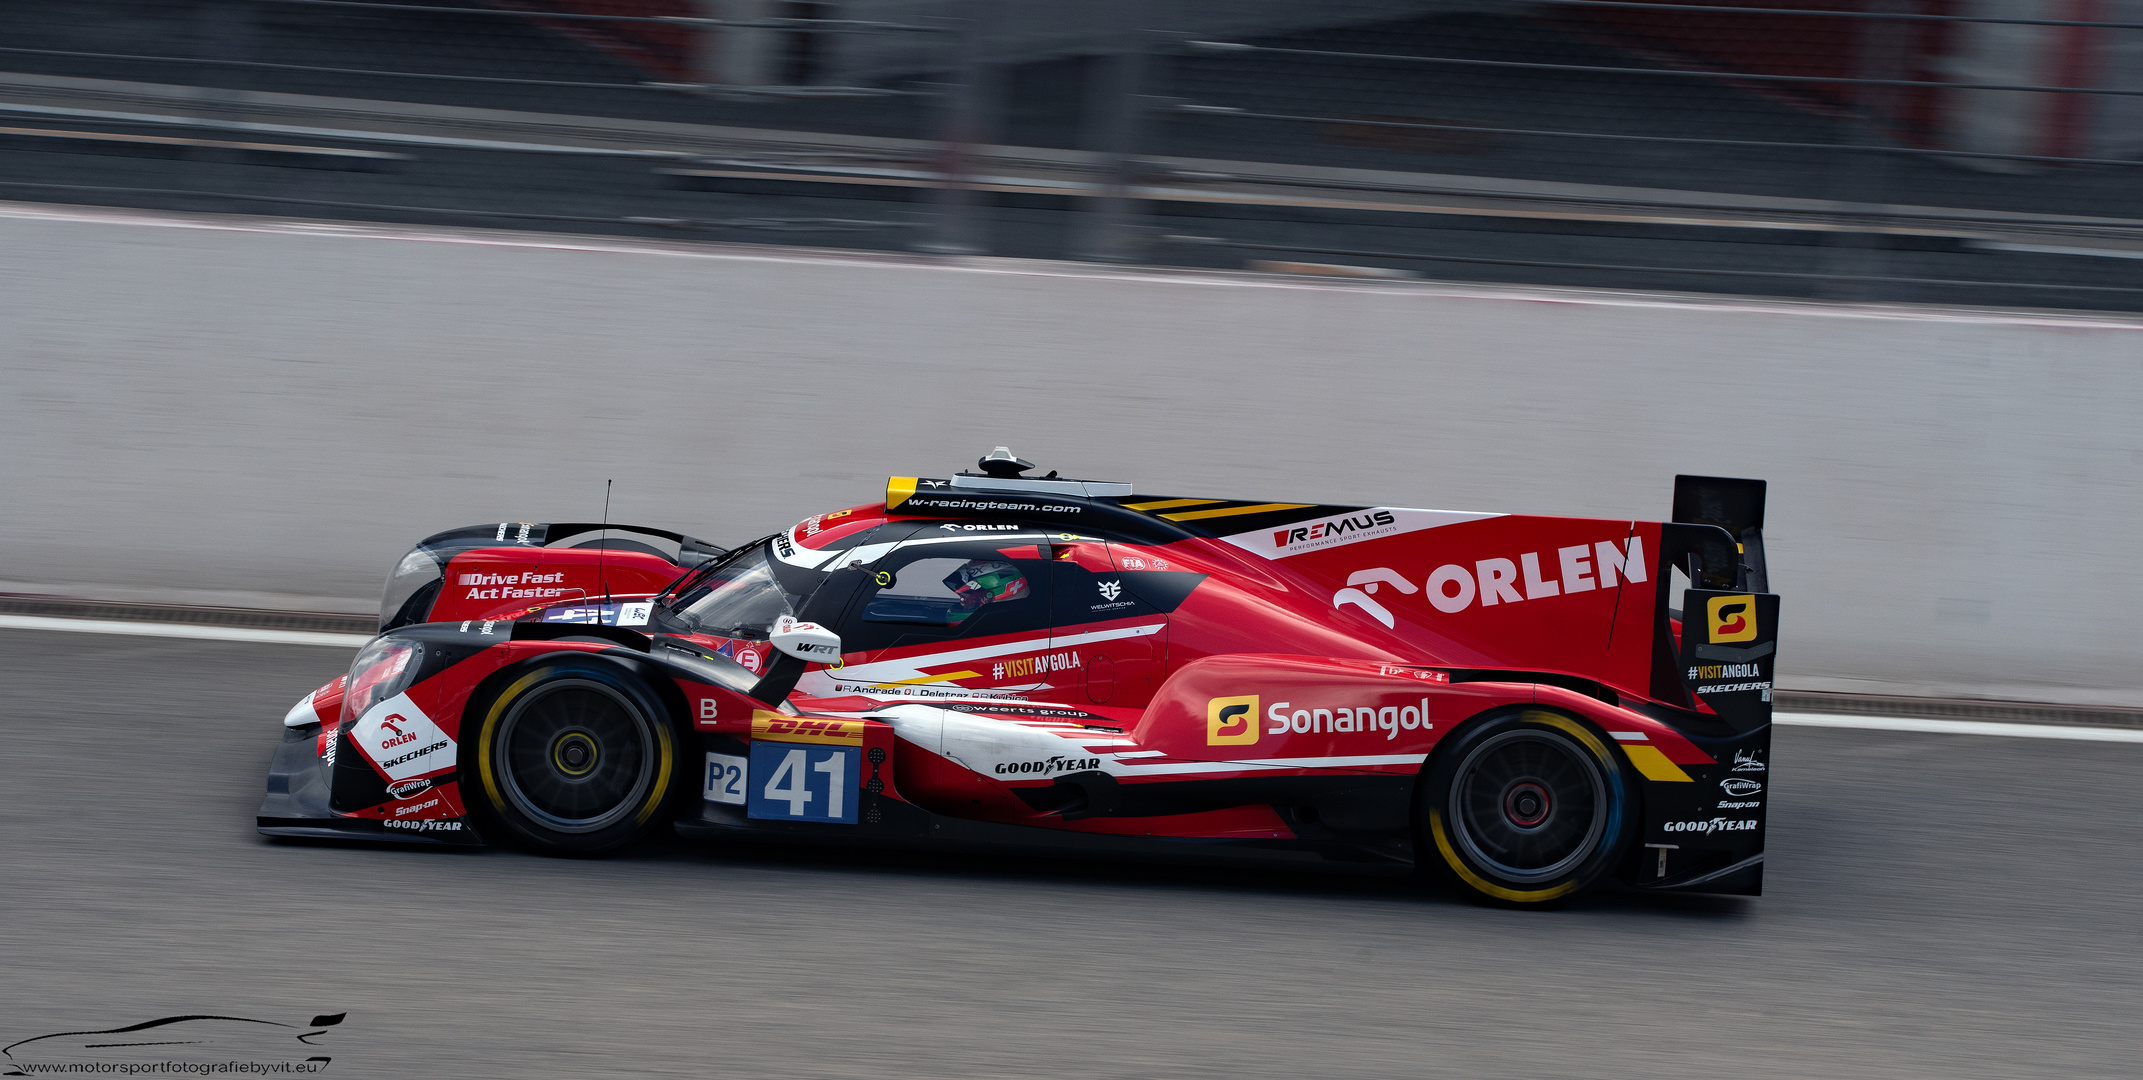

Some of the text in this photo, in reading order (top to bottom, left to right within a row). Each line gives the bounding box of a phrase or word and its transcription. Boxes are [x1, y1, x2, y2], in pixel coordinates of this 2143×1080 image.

[908, 499, 1081, 513] w-racingteam.com
[1289, 511, 1395, 544] REMUS
[1289, 526, 1397, 551] PERFORMANCE SPORT EXHAUSTS
[1122, 557, 1145, 569] FIA
[470, 572, 564, 585] Drive Fast
[1426, 536, 1647, 614] ORLEN
[466, 587, 562, 600] Act Faster
[1090, 601, 1135, 610] WELWITSCHIA
[796, 642, 838, 655] WRT
[992, 651, 1081, 680] #VISITANGOLA
[1688, 663, 1760, 680] #VISITANGOLA
[843, 685, 901, 695] R.Andrade
[1697, 681, 1771, 694] SKECHERS
[701, 698, 717, 718] B
[973, 706, 1089, 717] weerts group
[1268, 697, 1433, 741] Sonangol
[767, 719, 850, 738] DHL
[381, 732, 417, 750] ORLEN
[383, 740, 448, 769] SKECHERS
[708, 761, 742, 795] P2
[764, 749, 846, 818] 41
[1723, 781, 1762, 790] GrafiWrap
[390, 779, 431, 795] GrafiWrap
[395, 799, 438, 816] Snap-on
[1717, 800, 1760, 810] Snap-on
